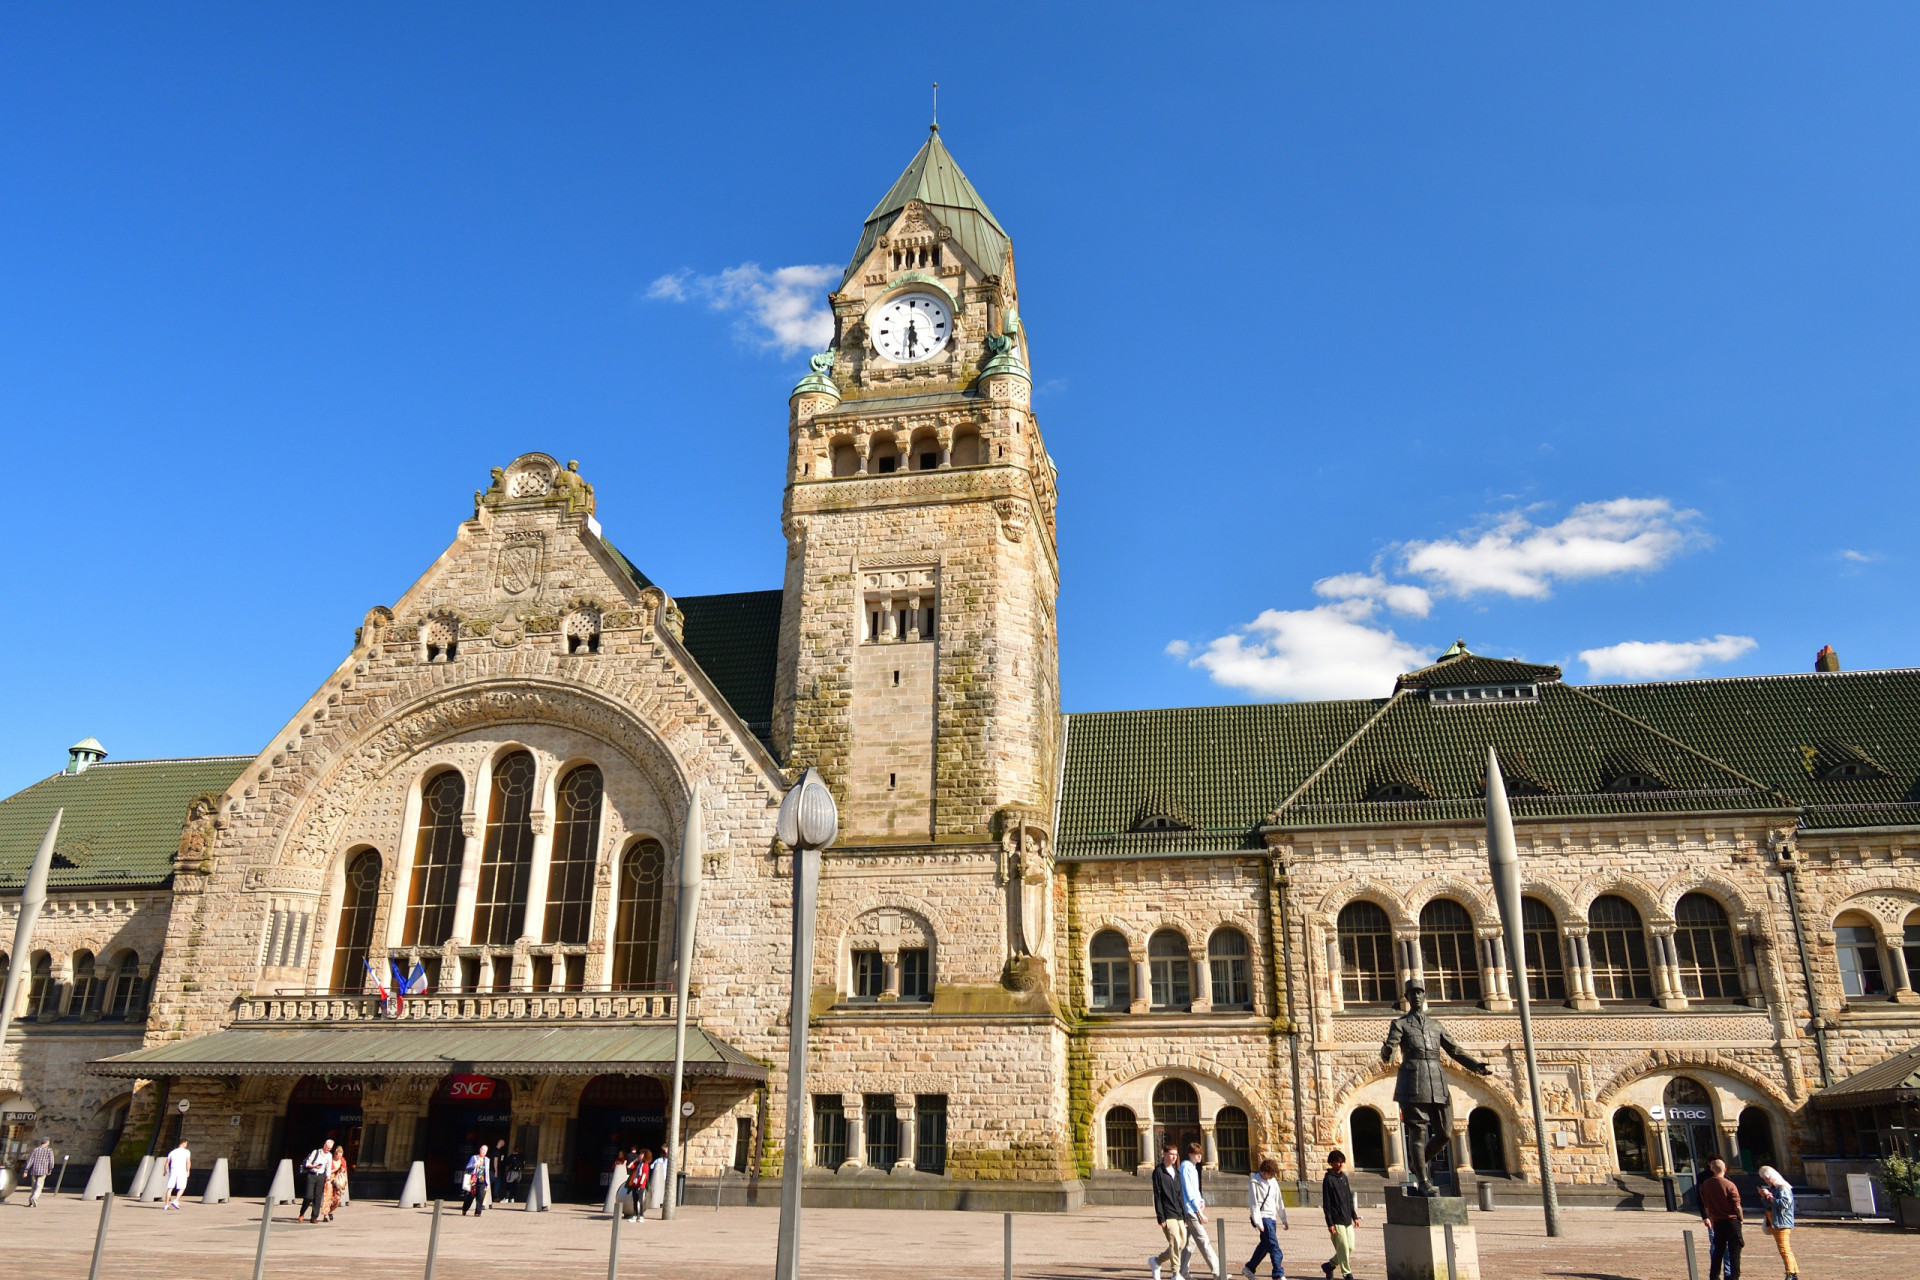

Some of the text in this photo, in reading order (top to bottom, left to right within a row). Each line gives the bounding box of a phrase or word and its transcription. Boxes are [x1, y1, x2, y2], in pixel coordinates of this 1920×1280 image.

[450, 1081, 492, 1095] SNCF
[637, 1115, 664, 1123] VOYAGE
[1669, 1107, 1706, 1119] fnac
